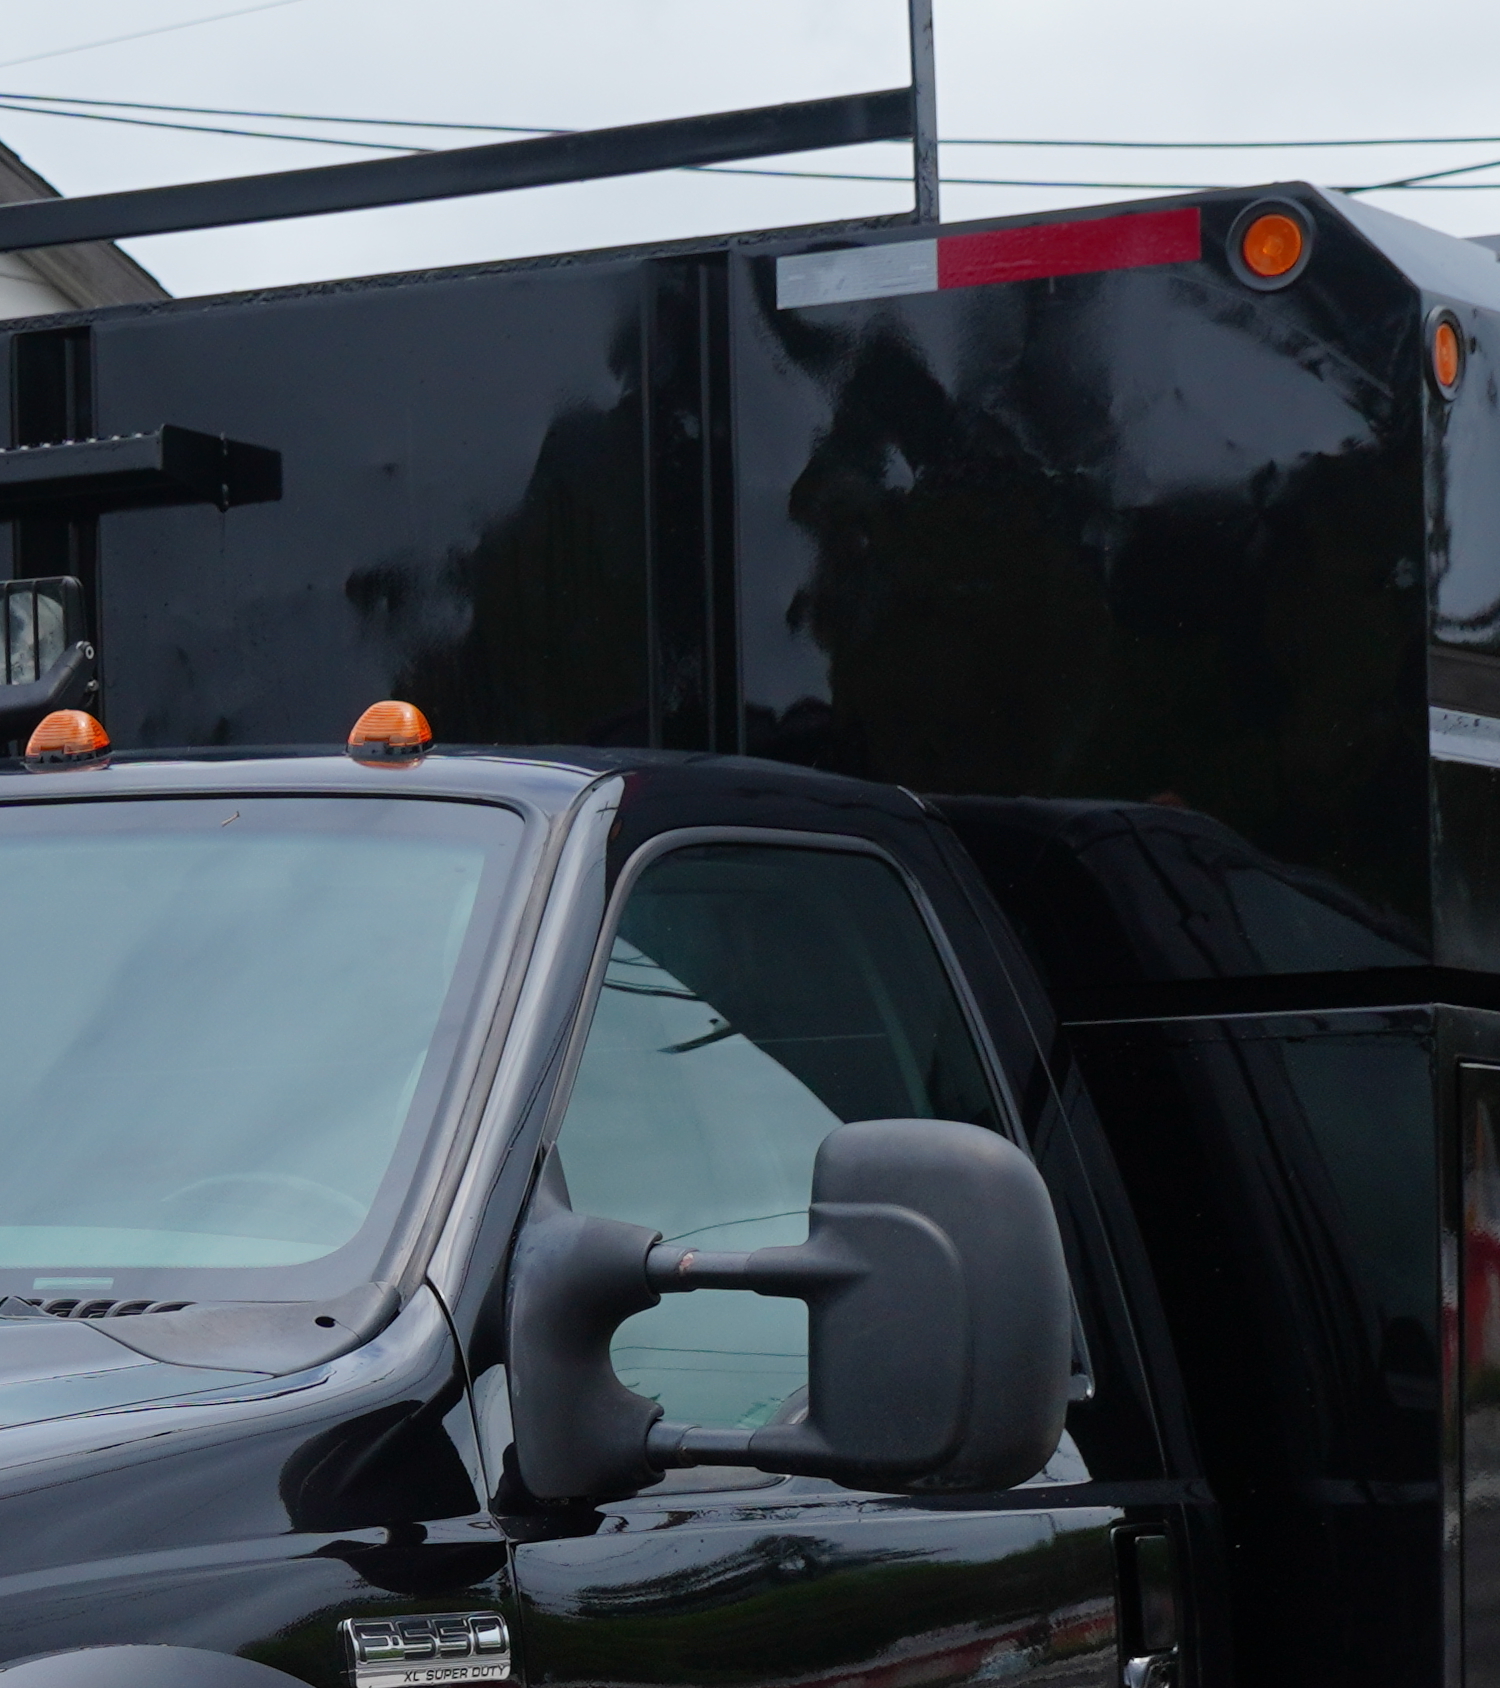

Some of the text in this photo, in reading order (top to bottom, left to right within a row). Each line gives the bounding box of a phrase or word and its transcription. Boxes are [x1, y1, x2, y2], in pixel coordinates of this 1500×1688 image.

[403, 1664, 509, 1683] XL SUPER DUTY
